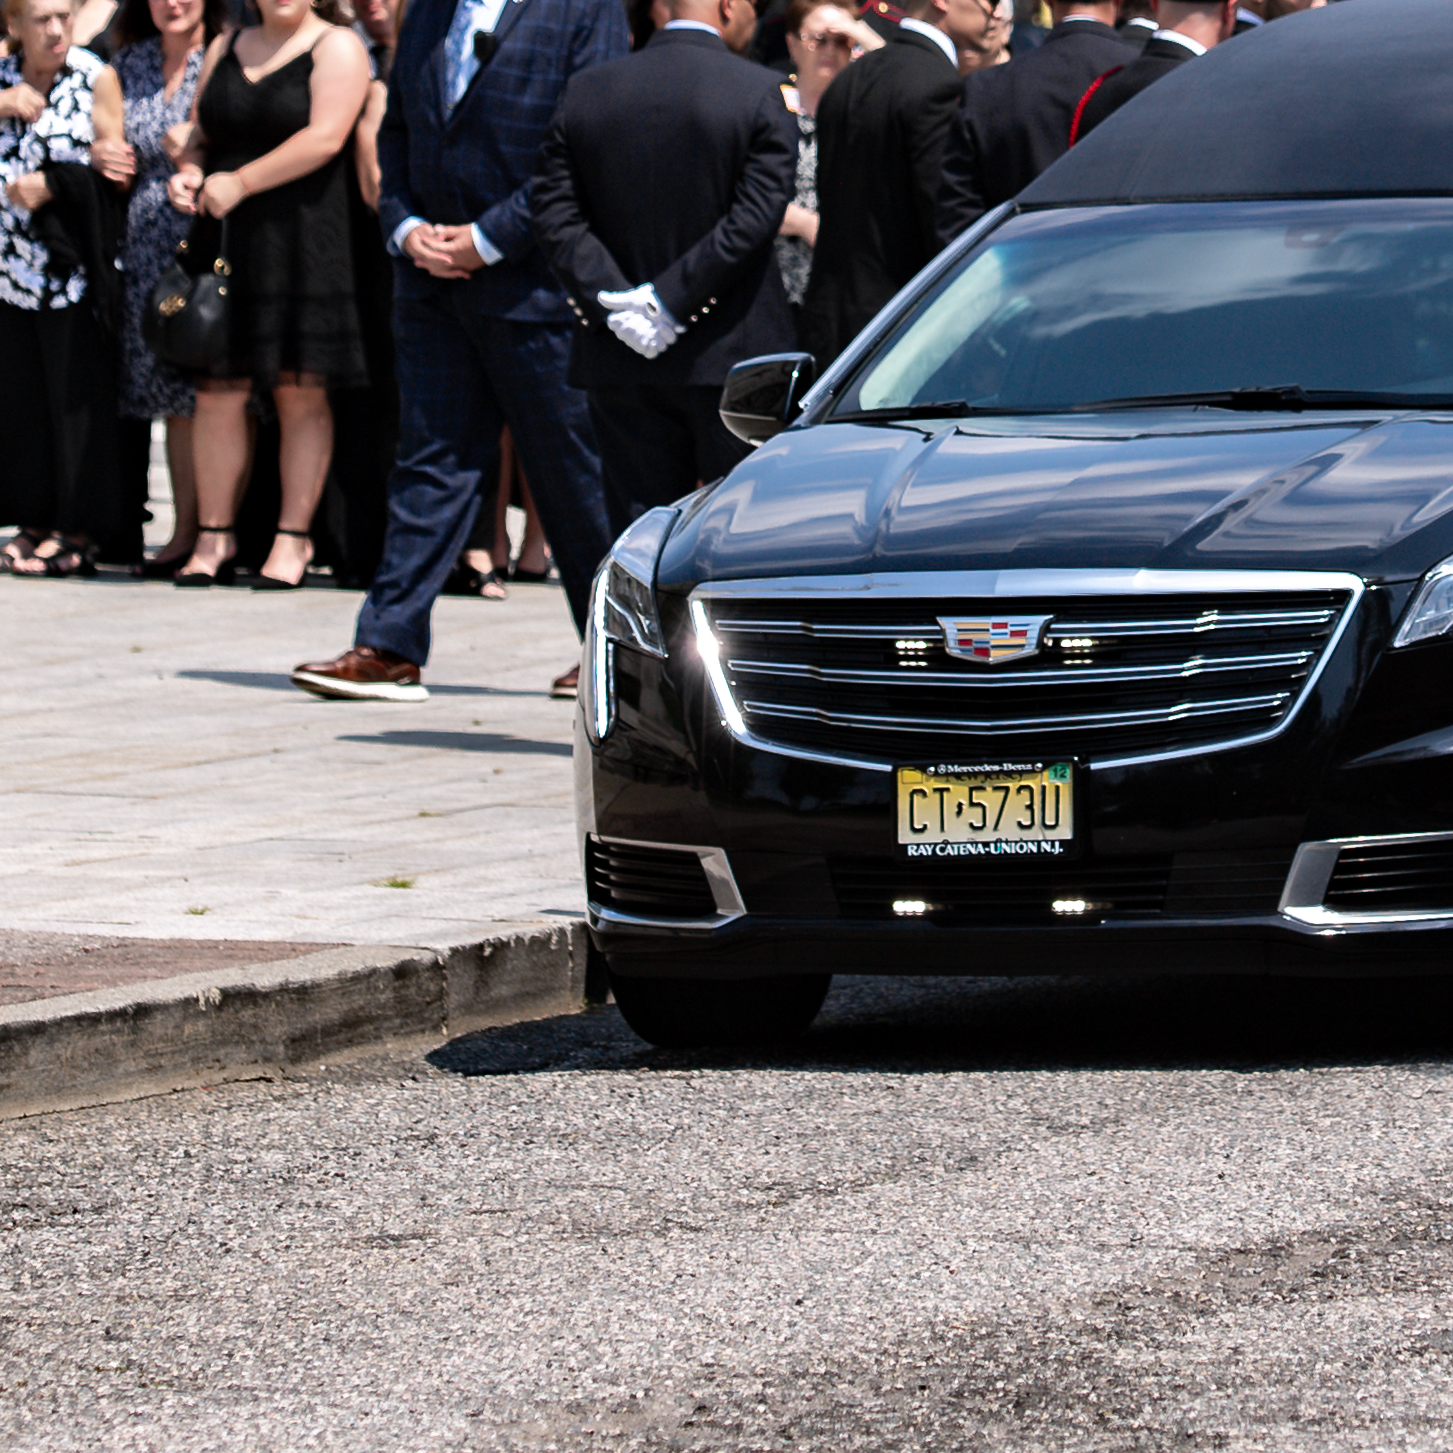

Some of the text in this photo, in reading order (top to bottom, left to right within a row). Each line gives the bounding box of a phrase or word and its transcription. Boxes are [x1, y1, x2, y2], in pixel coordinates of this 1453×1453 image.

[947, 763, 1033, 774] Mercedes-Benz
[1052, 766, 1067, 779] 12
[907, 844, 935, 856] RAY
[935, 842, 1038, 856] CATENA-UNION
[1040, 841, 1064, 855] N.J.
